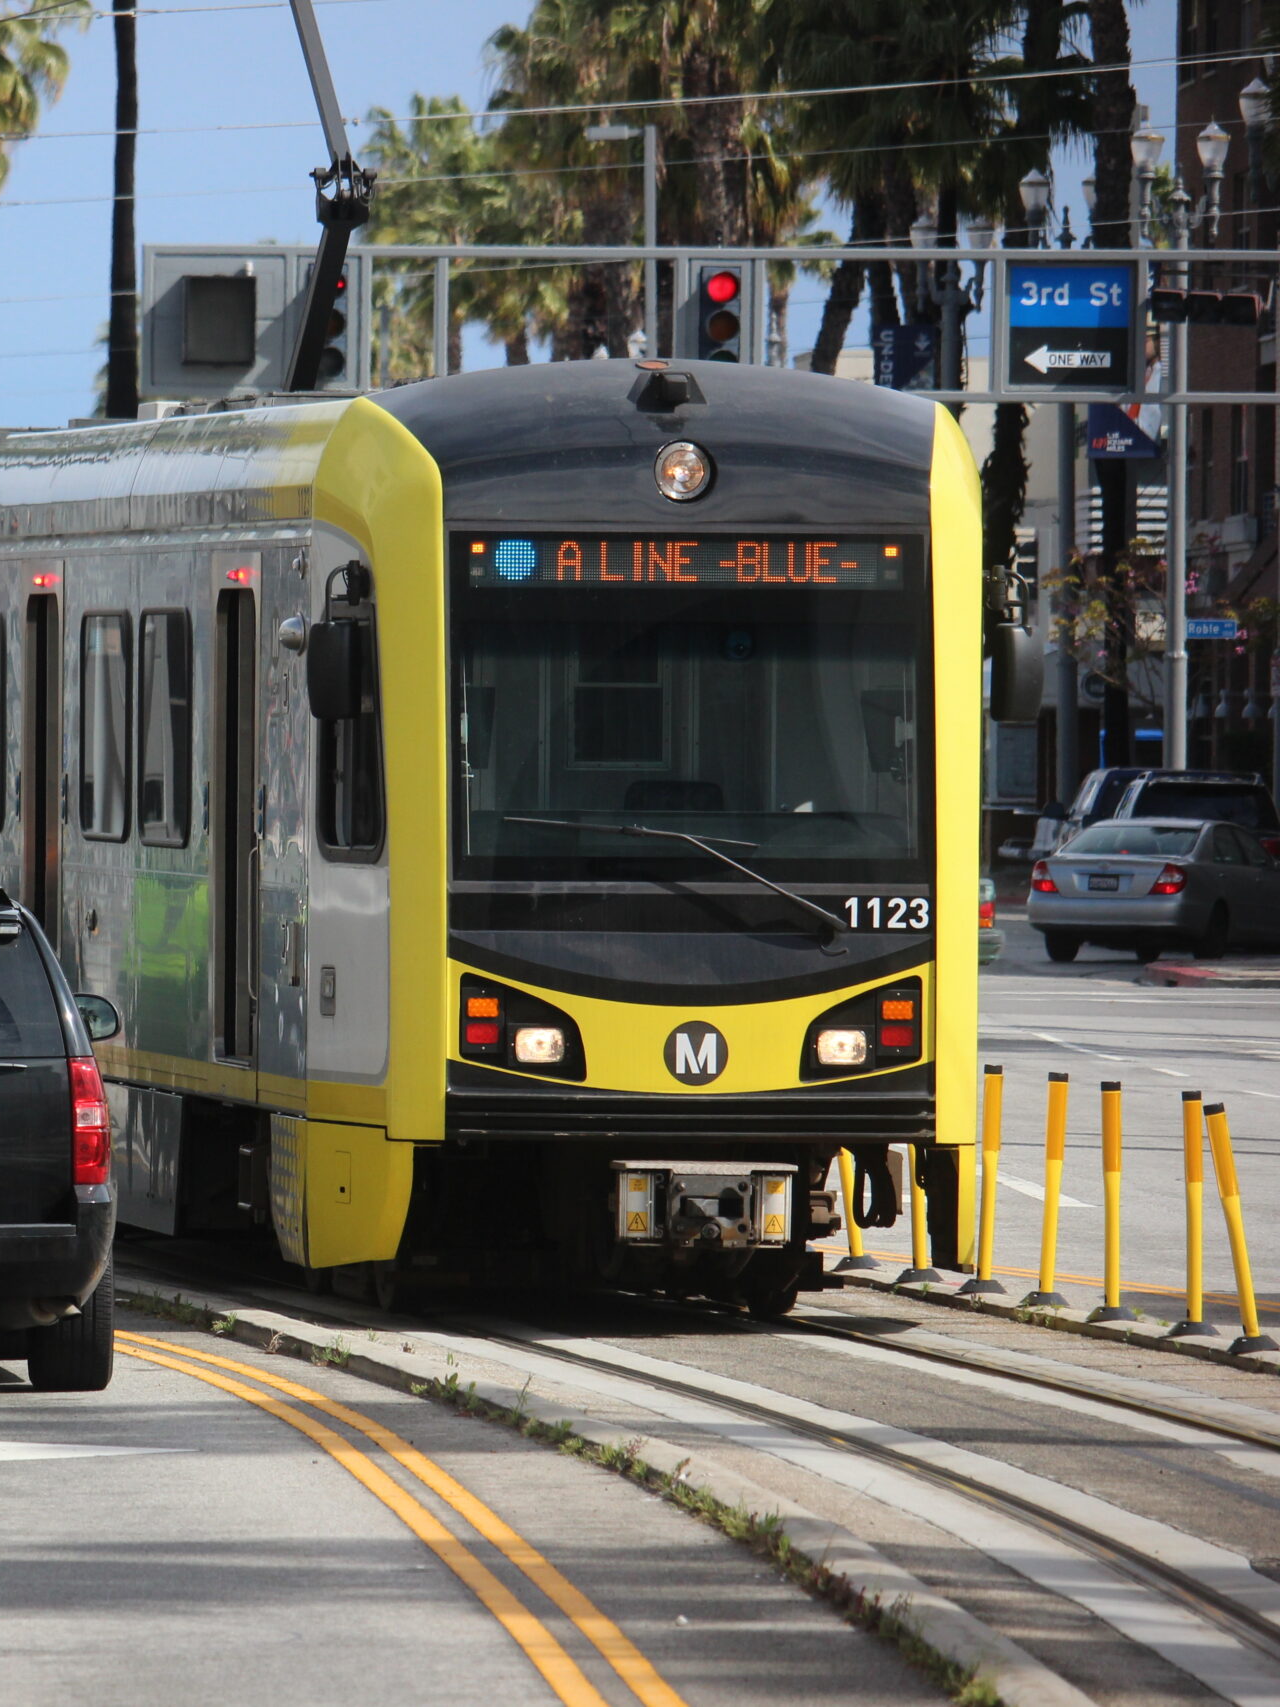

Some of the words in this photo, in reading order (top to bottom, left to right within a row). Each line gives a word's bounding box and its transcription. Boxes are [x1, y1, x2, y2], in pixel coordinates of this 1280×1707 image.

[1020, 281, 1069, 306] 3rd
[1089, 282, 1122, 306] St
[880, 330, 894, 388] UN-DE
[1048, 353, 1074, 366] ONE
[1080, 353, 1106, 366] WAY
[557, 541, 582, 581] A
[600, 541, 698, 582] LINE
[719, 541, 858, 583] -BLUE-
[1188, 622, 1220, 634] Roble
[844, 897, 930, 930] 1123
[675, 1032, 718, 1075] M
